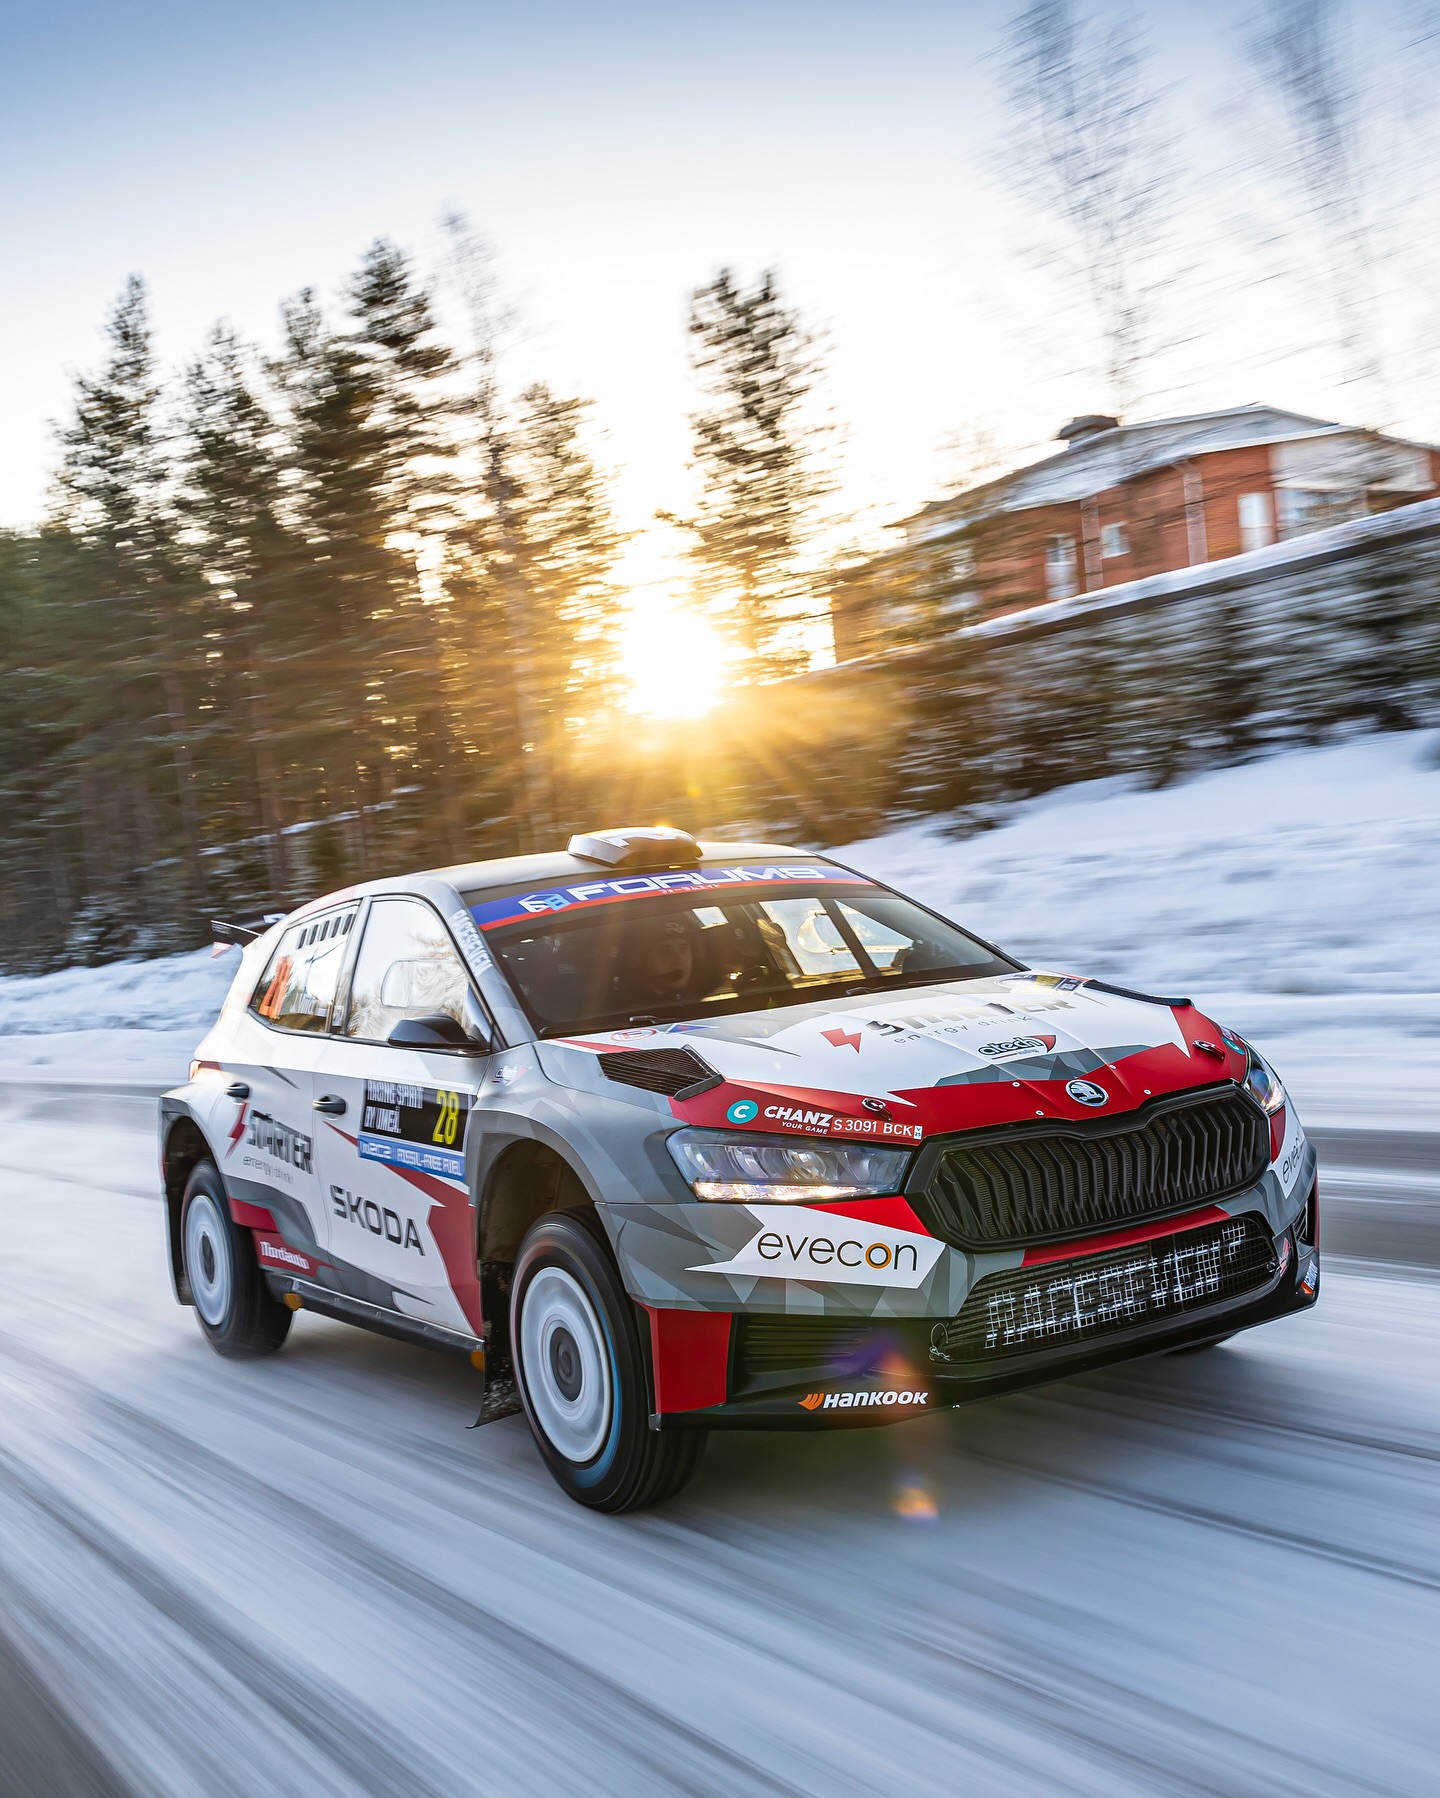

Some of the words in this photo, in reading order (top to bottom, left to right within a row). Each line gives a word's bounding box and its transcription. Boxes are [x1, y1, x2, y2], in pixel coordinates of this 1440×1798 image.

[566, 867, 826, 901] FORUM8
[432, 1089, 460, 1145] 28
[764, 1106, 833, 1127] CHANZ
[781, 1122, 804, 1130] YOUR
[805, 1126, 828, 1135] GAME
[833, 1119, 842, 1131] S
[844, 1119, 877, 1133] 3091
[883, 1123, 913, 1137] BCK
[757, 1232, 918, 1271] evecon
